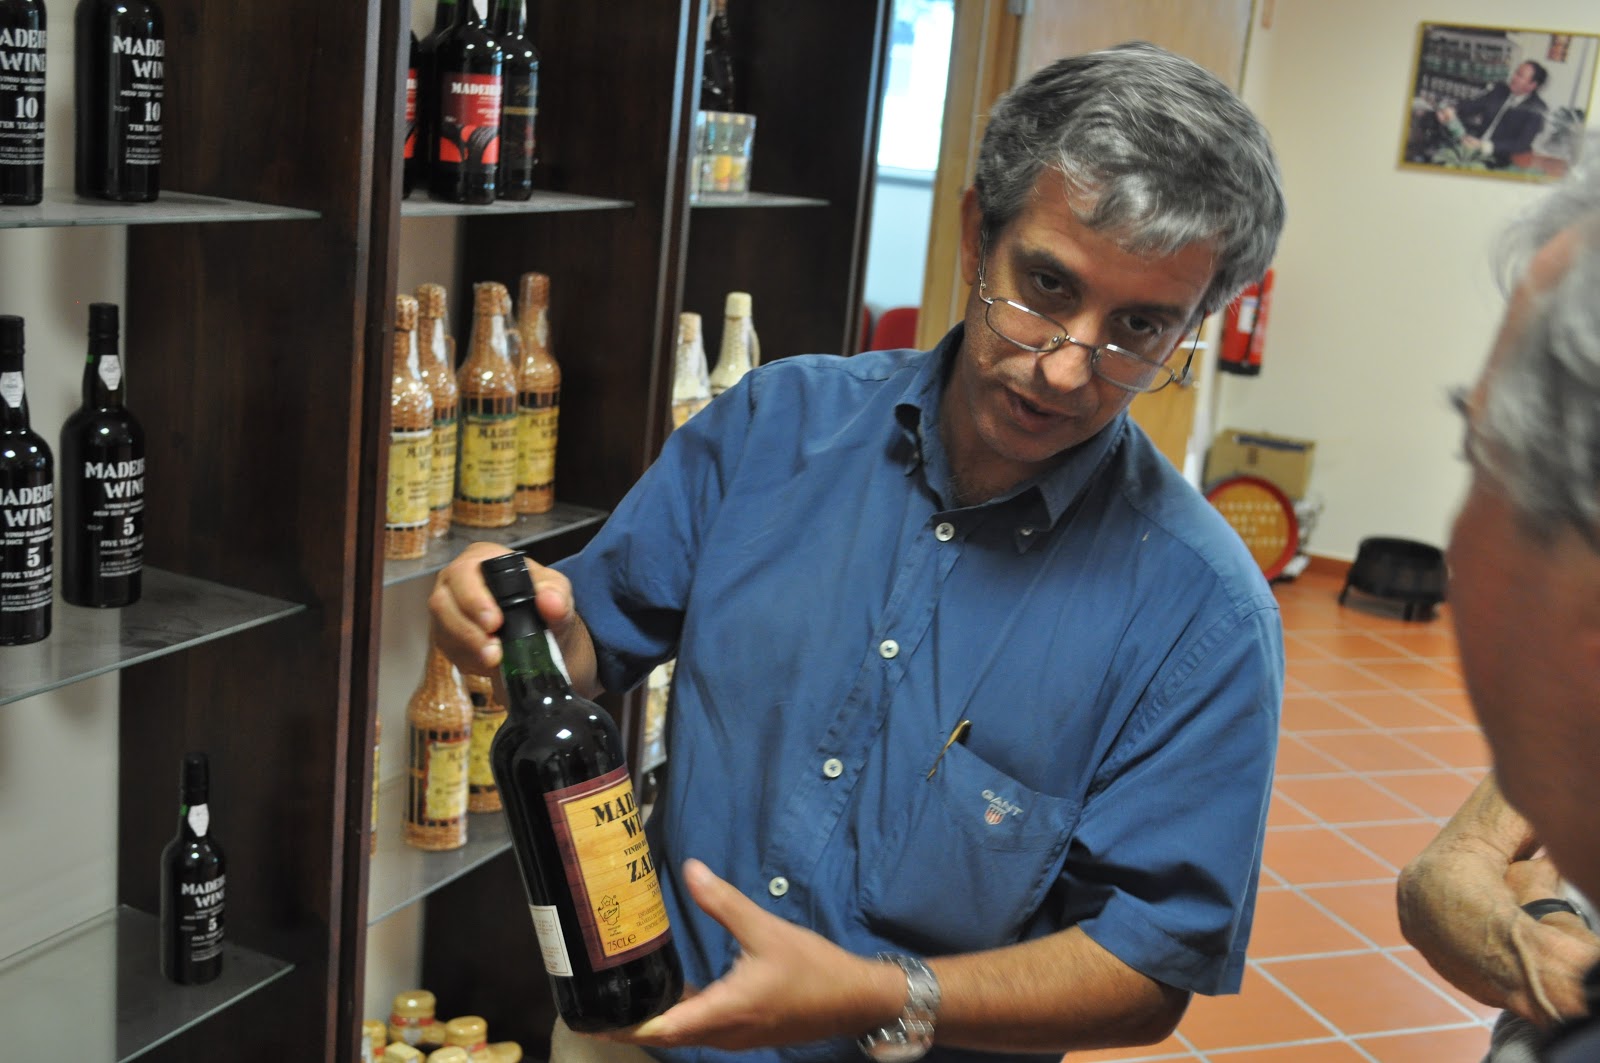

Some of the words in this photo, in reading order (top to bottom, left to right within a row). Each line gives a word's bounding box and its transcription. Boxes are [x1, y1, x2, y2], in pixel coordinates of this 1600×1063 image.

[15, 96, 39, 119] 10
[145, 101, 161, 121] 10
[122, 516, 136, 536] 5
[27, 546, 41, 568] 5
[981, 789, 1025, 817] GANT
[207, 917, 218, 932] 5
